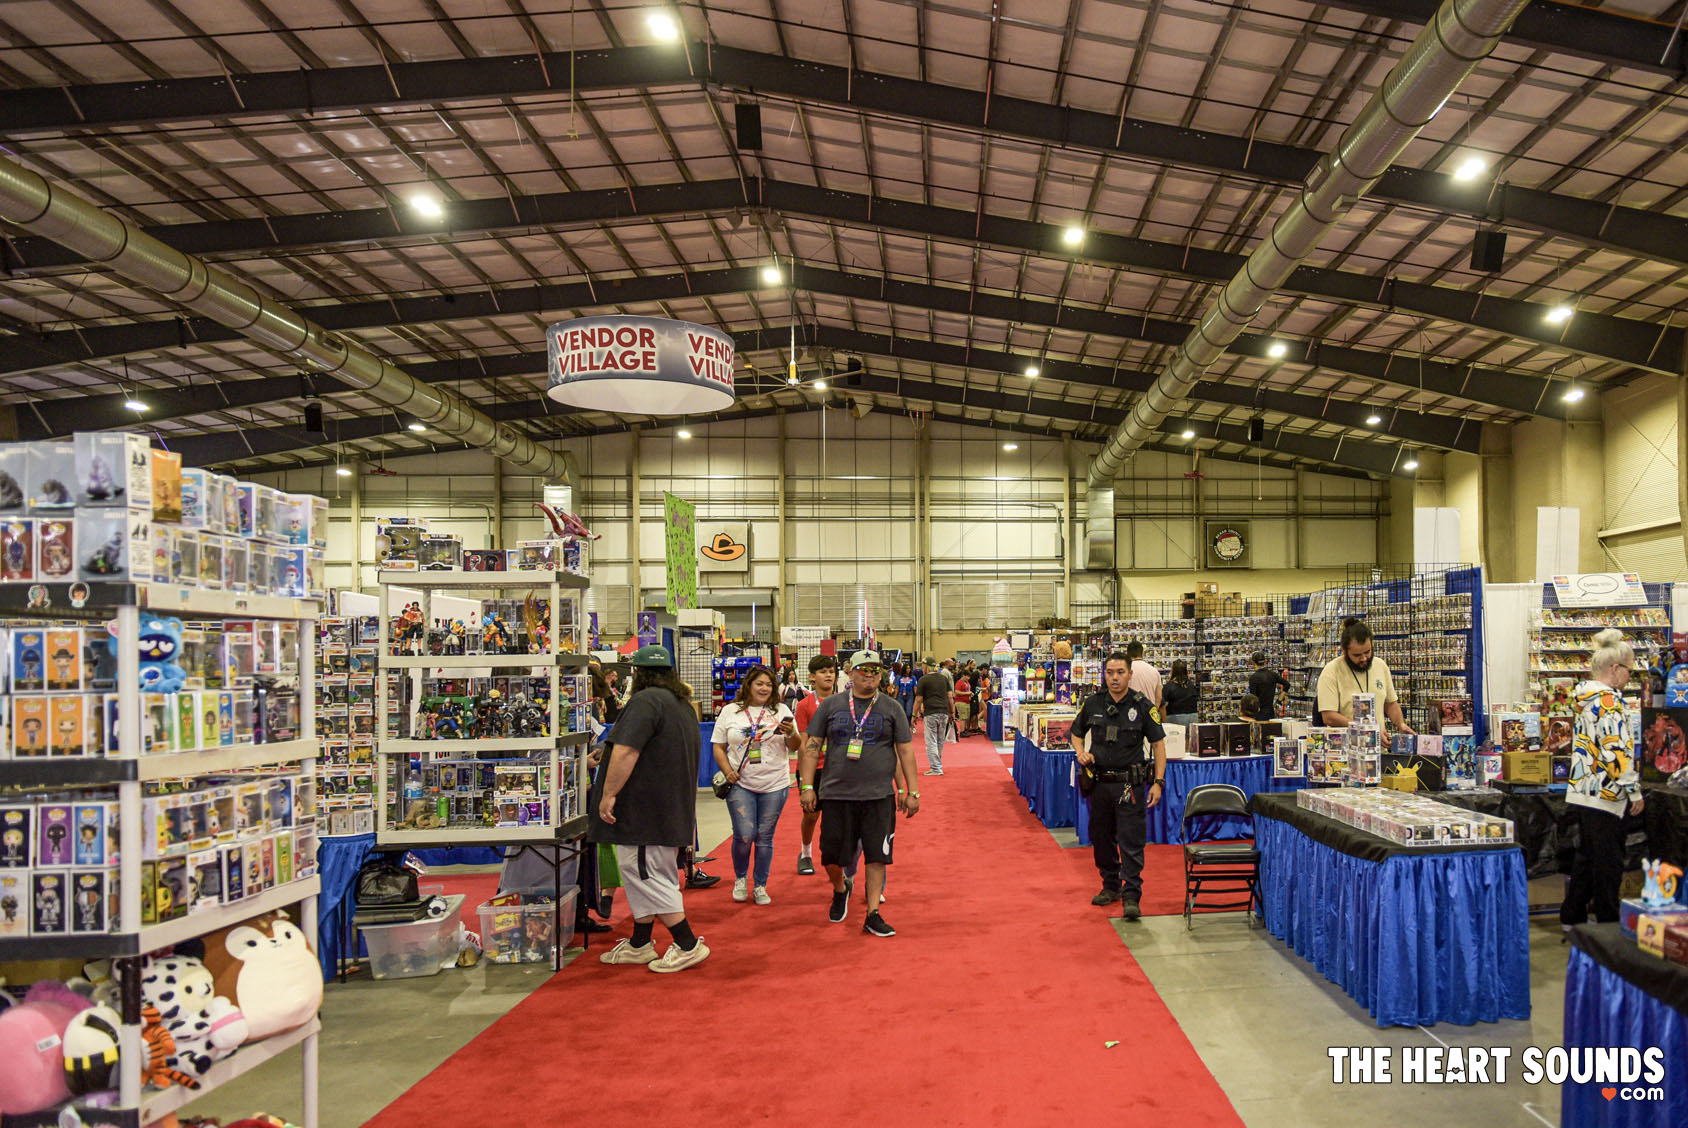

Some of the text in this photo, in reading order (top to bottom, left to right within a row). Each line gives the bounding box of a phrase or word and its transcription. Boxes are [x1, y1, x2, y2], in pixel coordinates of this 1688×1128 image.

[557, 327, 656, 353] VENDOR
[559, 350, 656, 375] VILLAGE
[689, 356, 734, 388] VILLA
